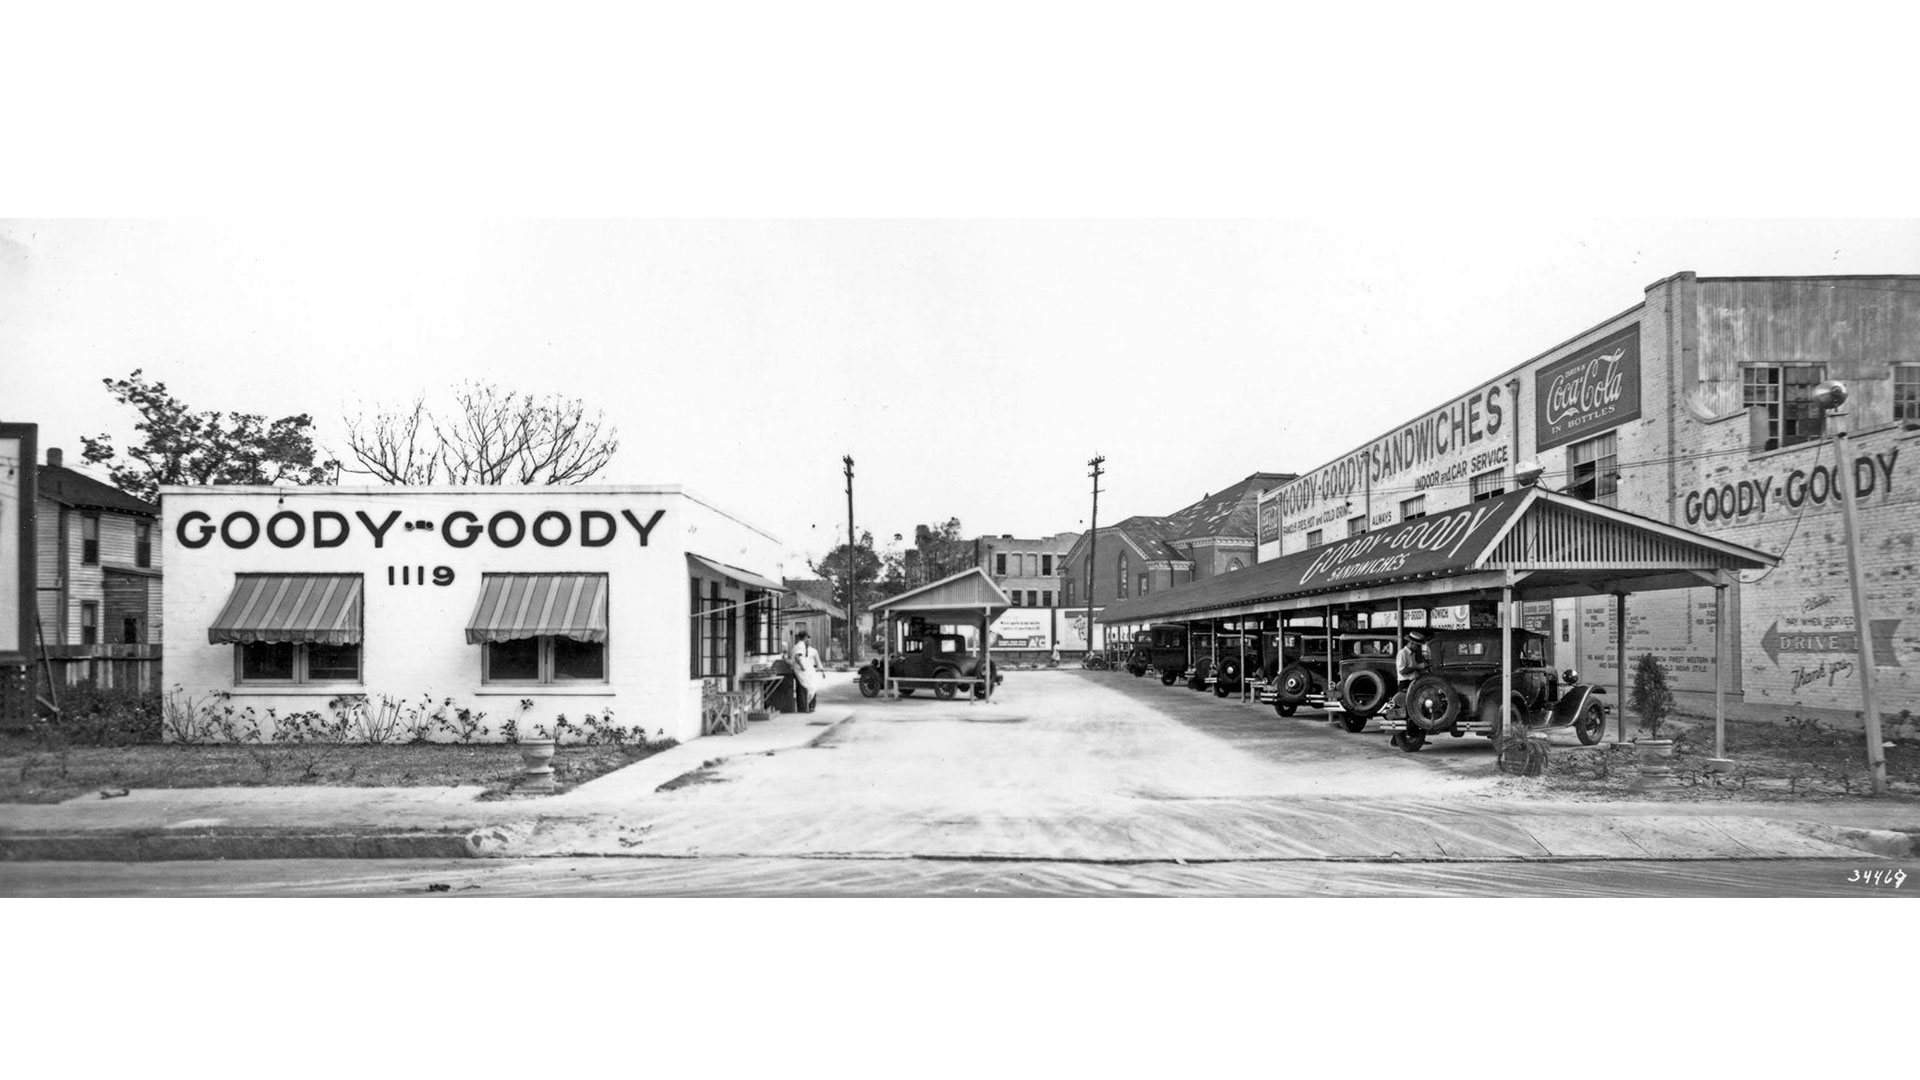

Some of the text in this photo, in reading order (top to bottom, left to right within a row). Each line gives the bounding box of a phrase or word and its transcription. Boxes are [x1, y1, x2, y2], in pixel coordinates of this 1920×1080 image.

[1565, 364, 1586, 378] DRINK
[1551, 404, 1616, 434] IN BOTTLES
[1372, 385, 1502, 483] SANDWICHES
[1415, 470, 1440, 492] INDOOR
[1452, 460, 1468, 480] CAR
[1471, 445, 1508, 473] SERVICE
[1324, 508, 1335, 524] COLD
[1372, 511, 1392, 527] ALWAYS
[1299, 502, 1504, 585] GOODY-GOODY
[388, 565, 456, 587] 1119
[1327, 552, 1410, 582] SANDWICHES
[1780, 634, 1838, 651] DRIVE
